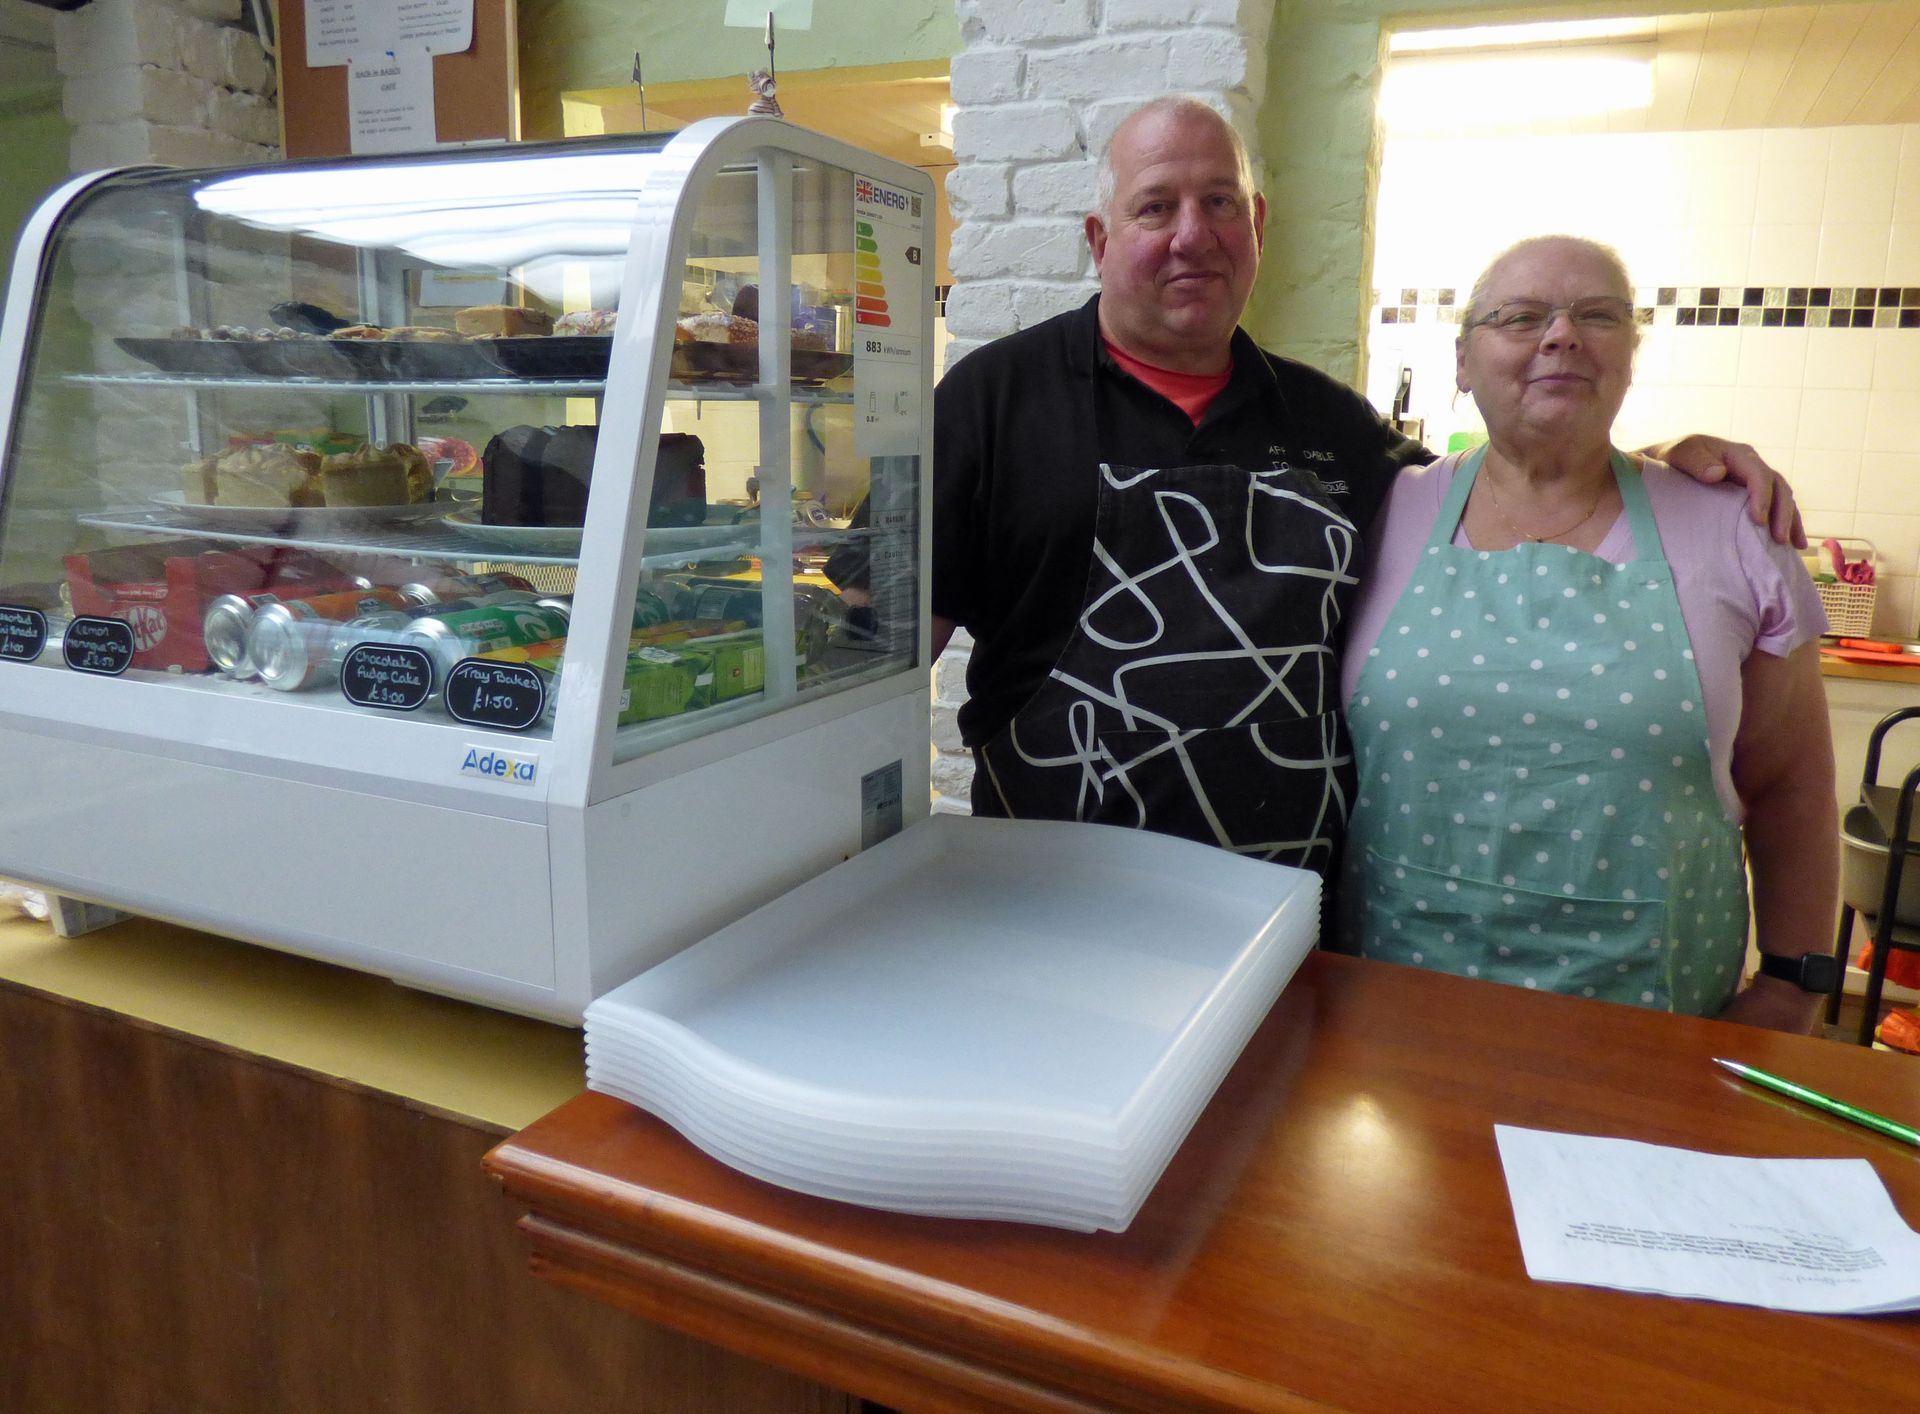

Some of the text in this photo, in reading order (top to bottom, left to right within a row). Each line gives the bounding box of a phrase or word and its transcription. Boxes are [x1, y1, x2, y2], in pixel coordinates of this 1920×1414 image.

[866, 340, 882, 353] 883
[355, 650, 418, 670] Chocolate
[391, 670, 421, 686] Cake
[457, 667, 539, 690] Tray Bakes
[461, 749, 535, 781] Adexa
